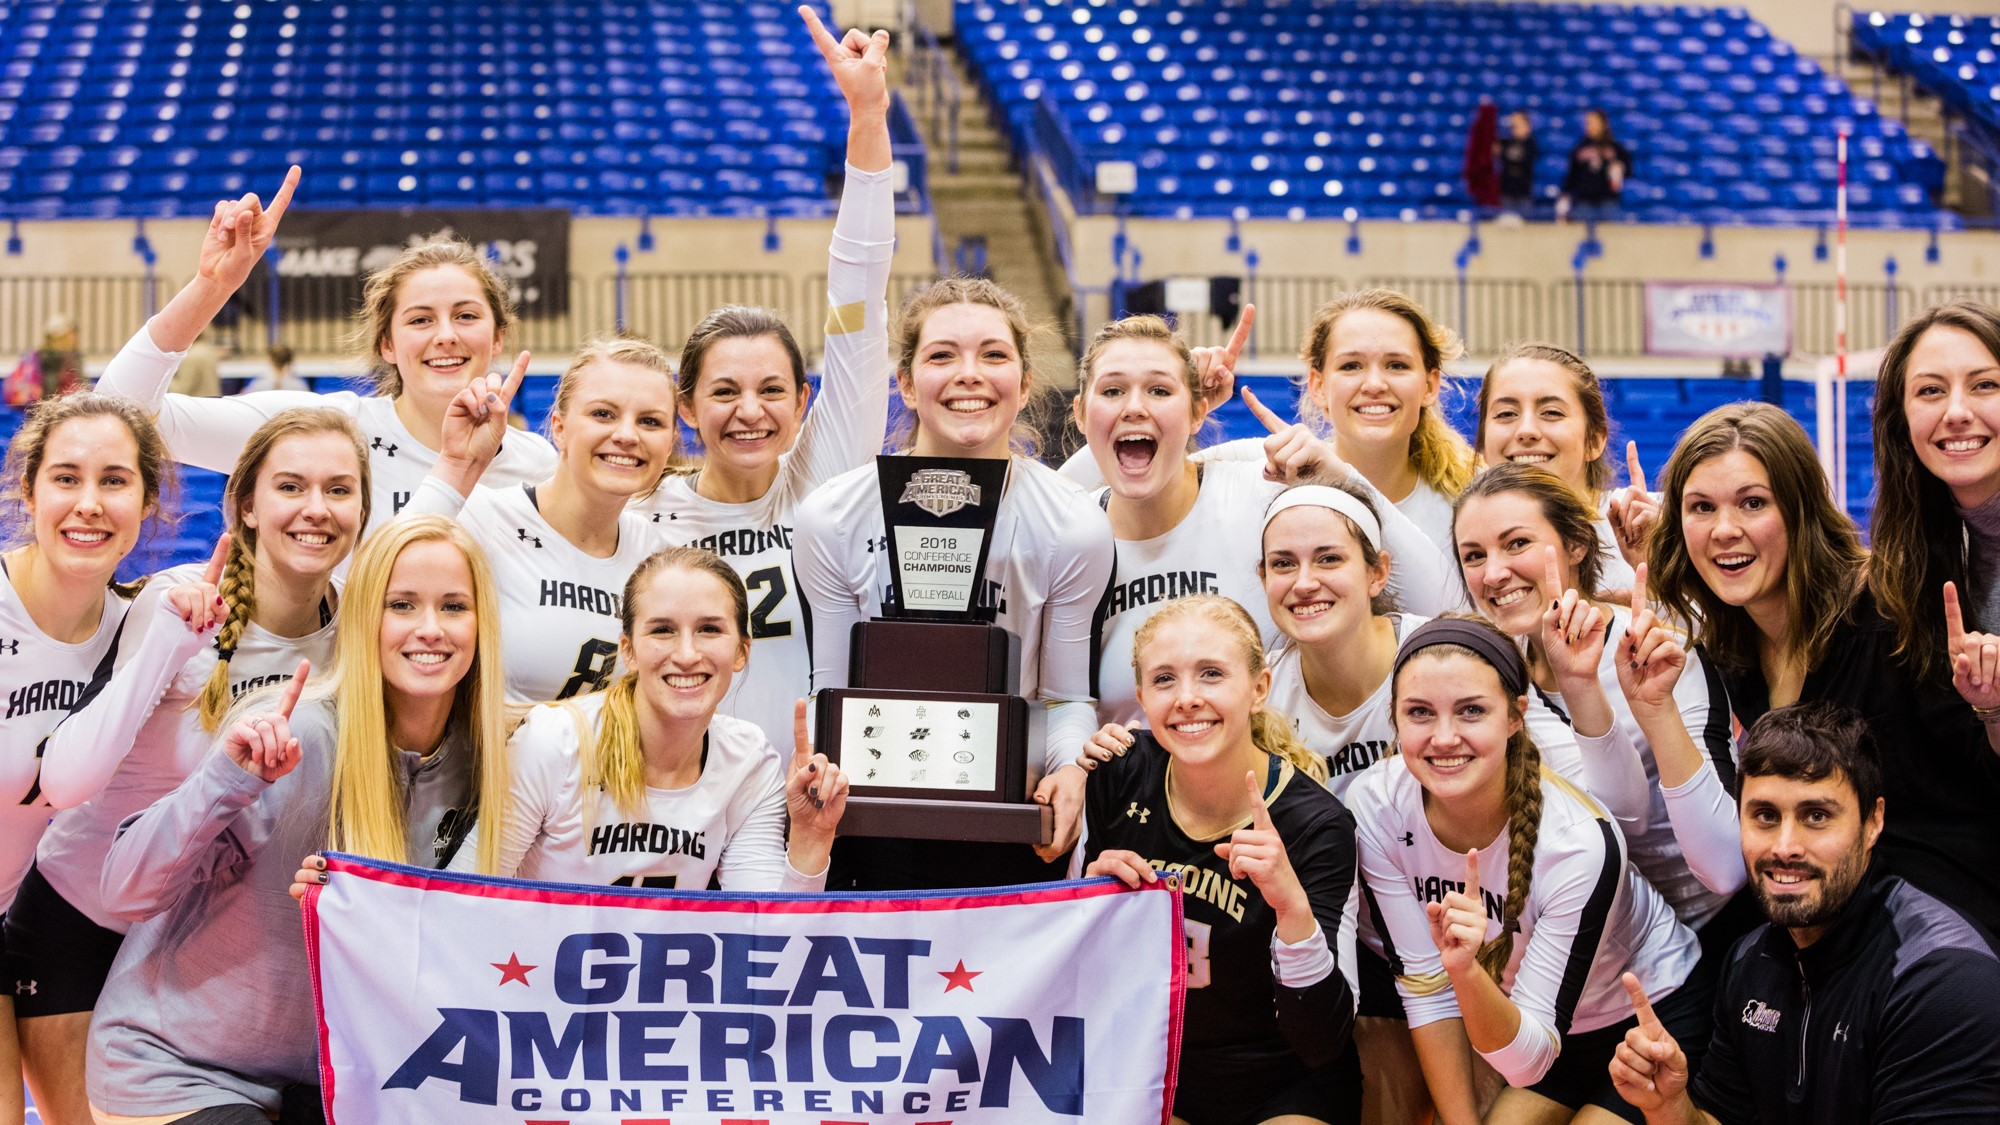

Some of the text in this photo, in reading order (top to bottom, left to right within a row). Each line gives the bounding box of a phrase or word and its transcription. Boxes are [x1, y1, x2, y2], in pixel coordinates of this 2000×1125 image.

[921, 473, 961, 485] GREAT
[901, 484, 981, 505] AMERICAN
[683, 524, 794, 557] ARDING
[920, 537, 957, 550] 2018
[904, 551, 972, 563] CONFERENCE
[904, 562, 972, 574] CHAMPIONS
[908, 589, 965, 601] VOLLEYBALL
[1104, 571, 1219, 621] ARDING
[588, 822, 706, 860] HARDING
[554, 932, 932, 1009] GREAT
[381, 1007, 1085, 1117] AMERICAN
[511, 1088, 971, 1115] CONFERENCE
